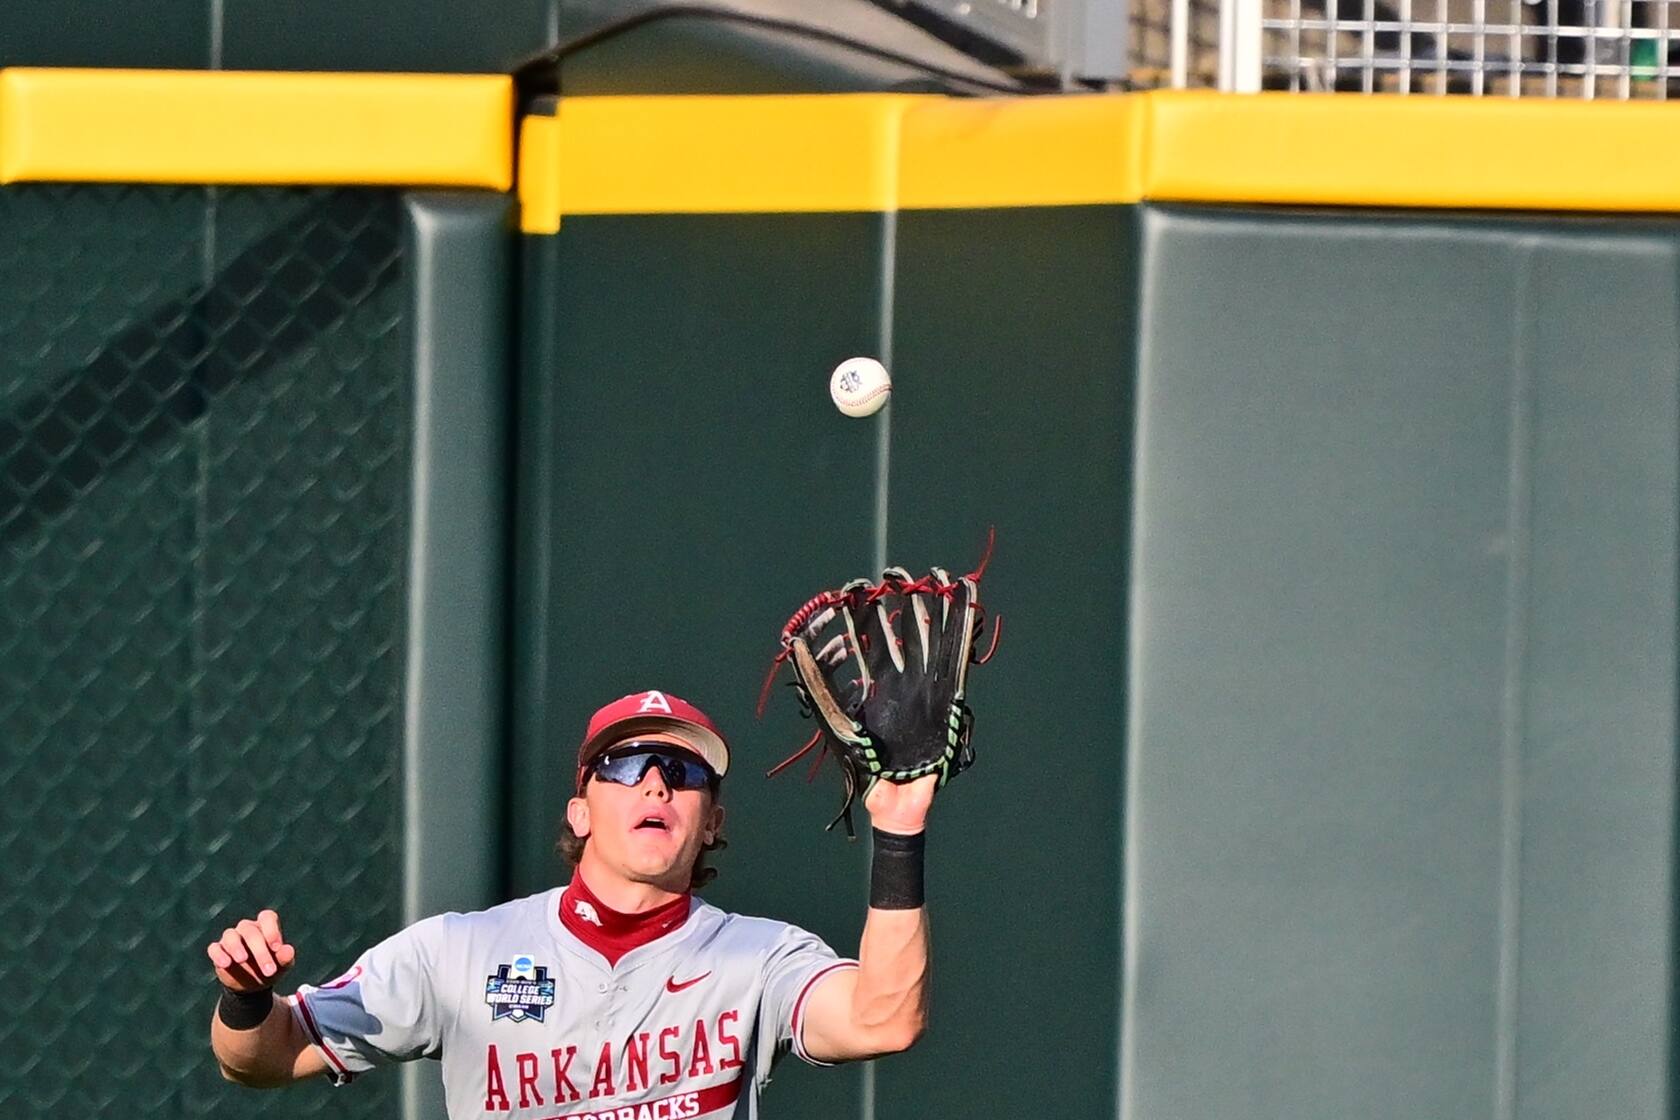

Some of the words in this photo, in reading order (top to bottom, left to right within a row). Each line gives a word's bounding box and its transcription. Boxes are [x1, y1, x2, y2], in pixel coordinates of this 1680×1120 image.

[637, 690, 673, 713] A
[501, 984, 541, 995] COLLEGE
[487, 993, 519, 1003] WORLD
[520, 995, 553, 1006] SERIES
[485, 1010, 744, 1112] ARKANSAS
